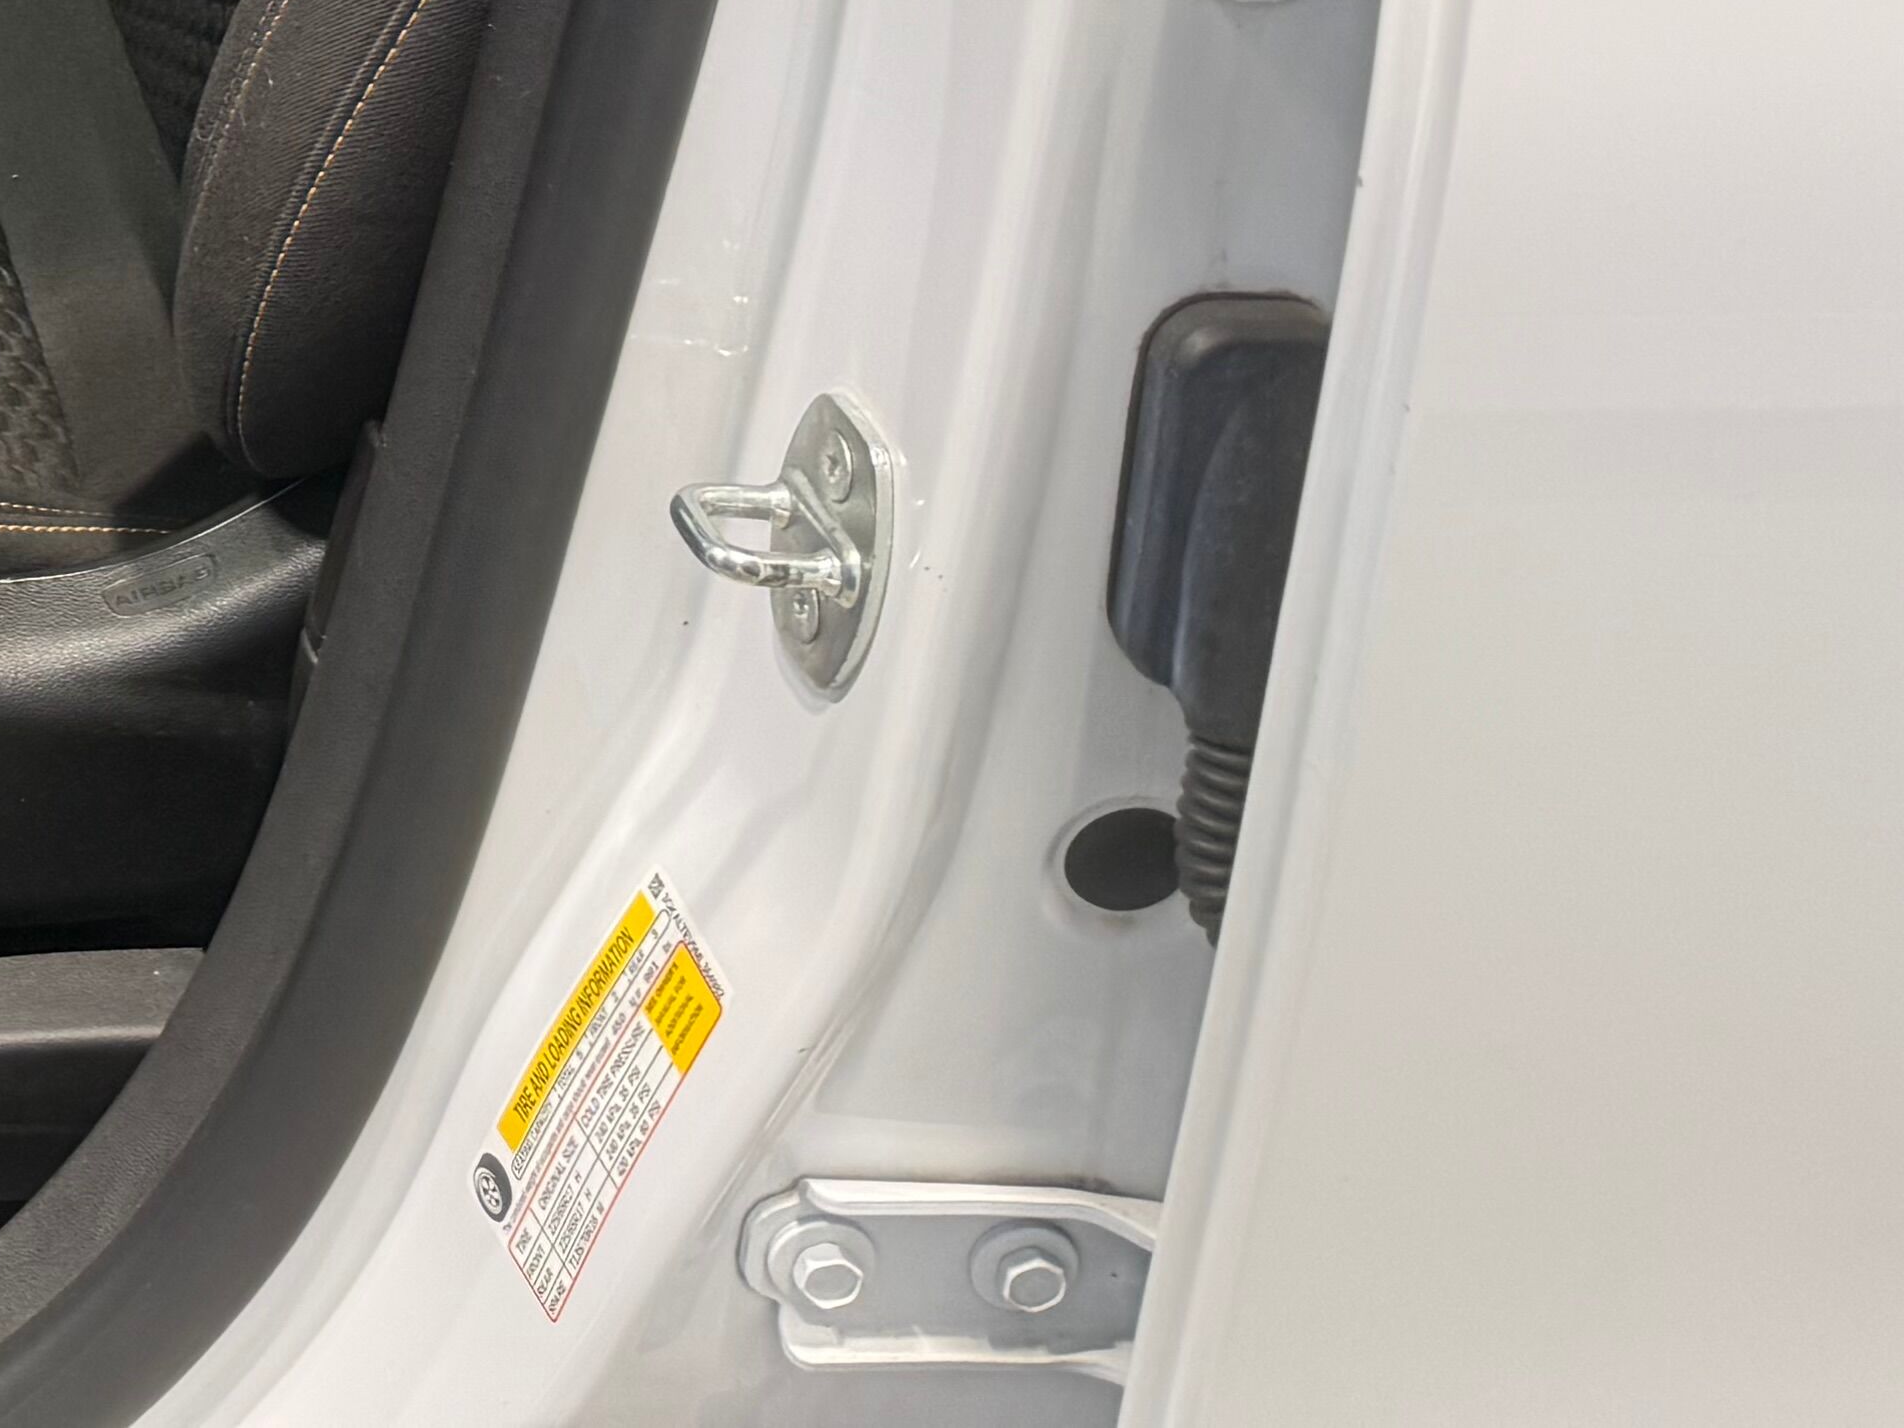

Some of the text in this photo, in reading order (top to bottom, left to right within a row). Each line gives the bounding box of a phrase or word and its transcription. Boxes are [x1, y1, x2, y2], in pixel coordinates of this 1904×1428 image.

[512, 923, 633, 1124] TIRE AND LOADING INFORMATION
[580, 1094, 600, 1129] COLD
[515, 1226, 532, 1254] TIRE
